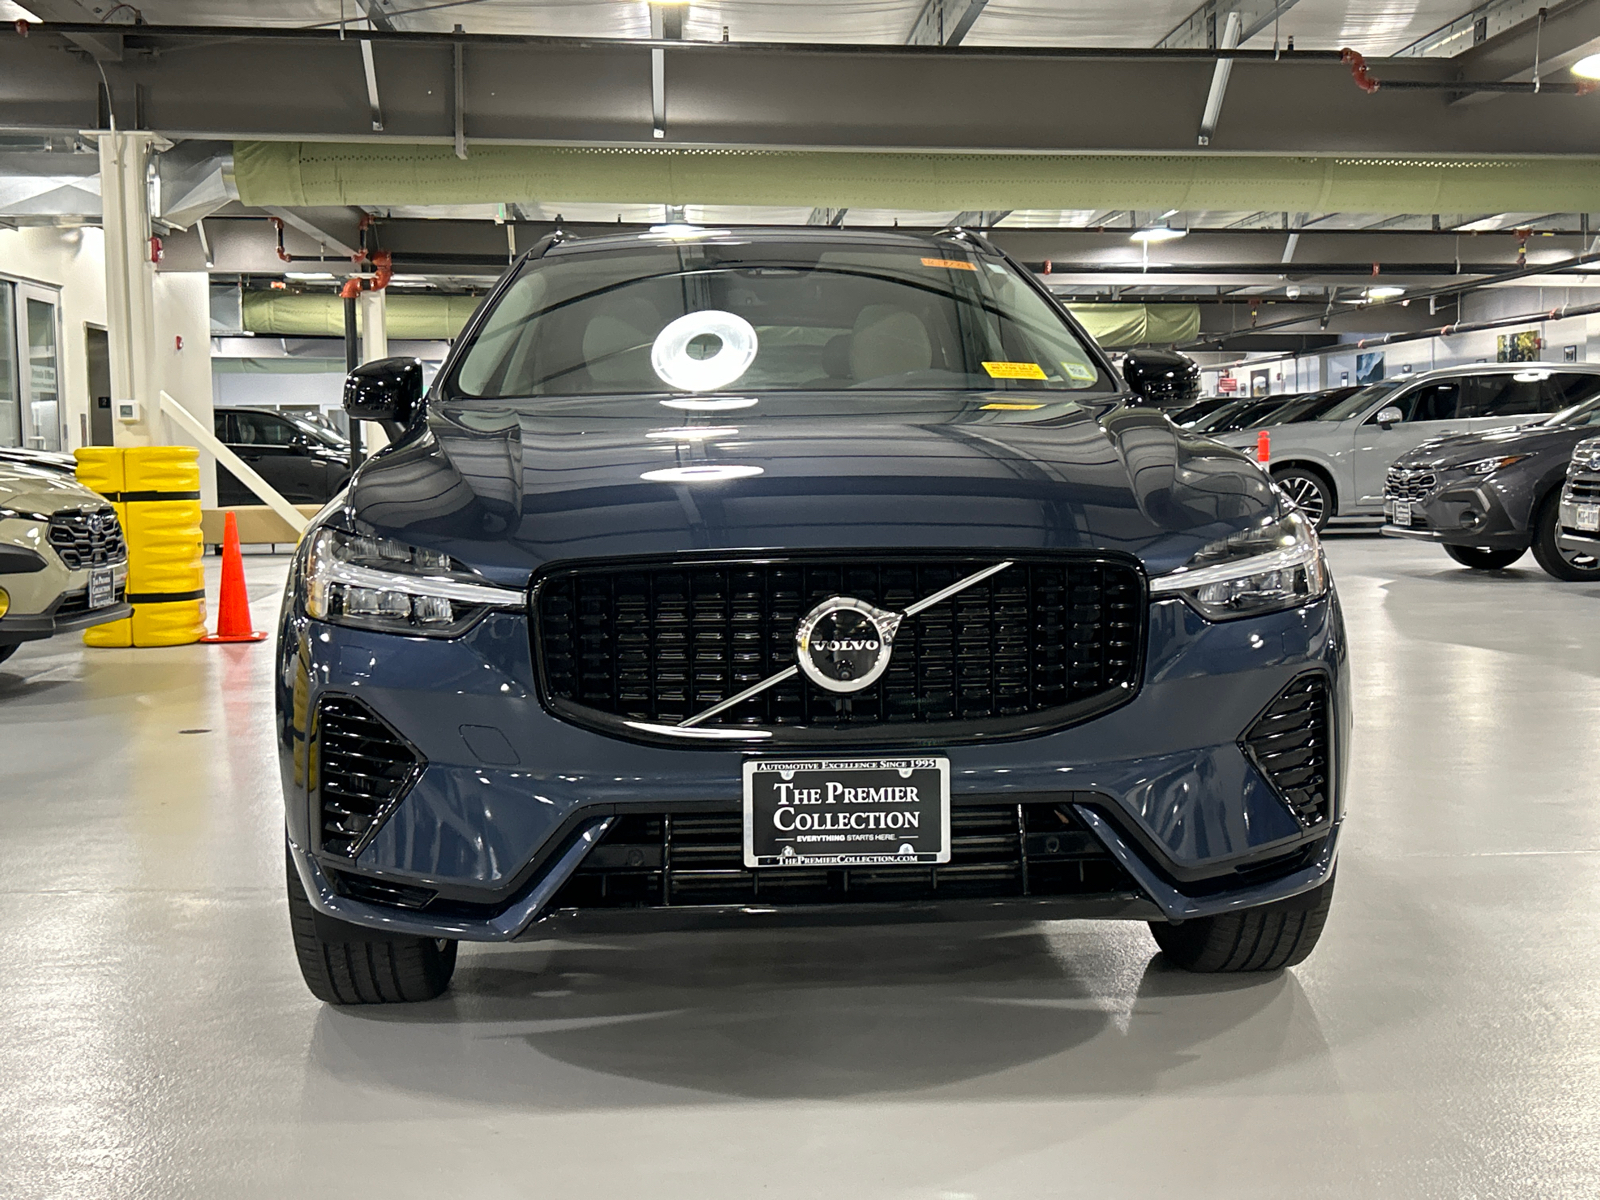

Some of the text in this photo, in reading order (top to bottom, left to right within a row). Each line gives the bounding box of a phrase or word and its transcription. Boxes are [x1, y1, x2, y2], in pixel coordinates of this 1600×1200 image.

[811, 640, 879, 651] VOLVO
[759, 759, 936, 771] AUTOMOTIVE EXCELLENCE SINCE 1995
[773, 782, 920, 805] THE PREMIER
[773, 806, 920, 831] COLLECTION
[796, 833, 898, 843] EVERYTHING STARTS HERE.
